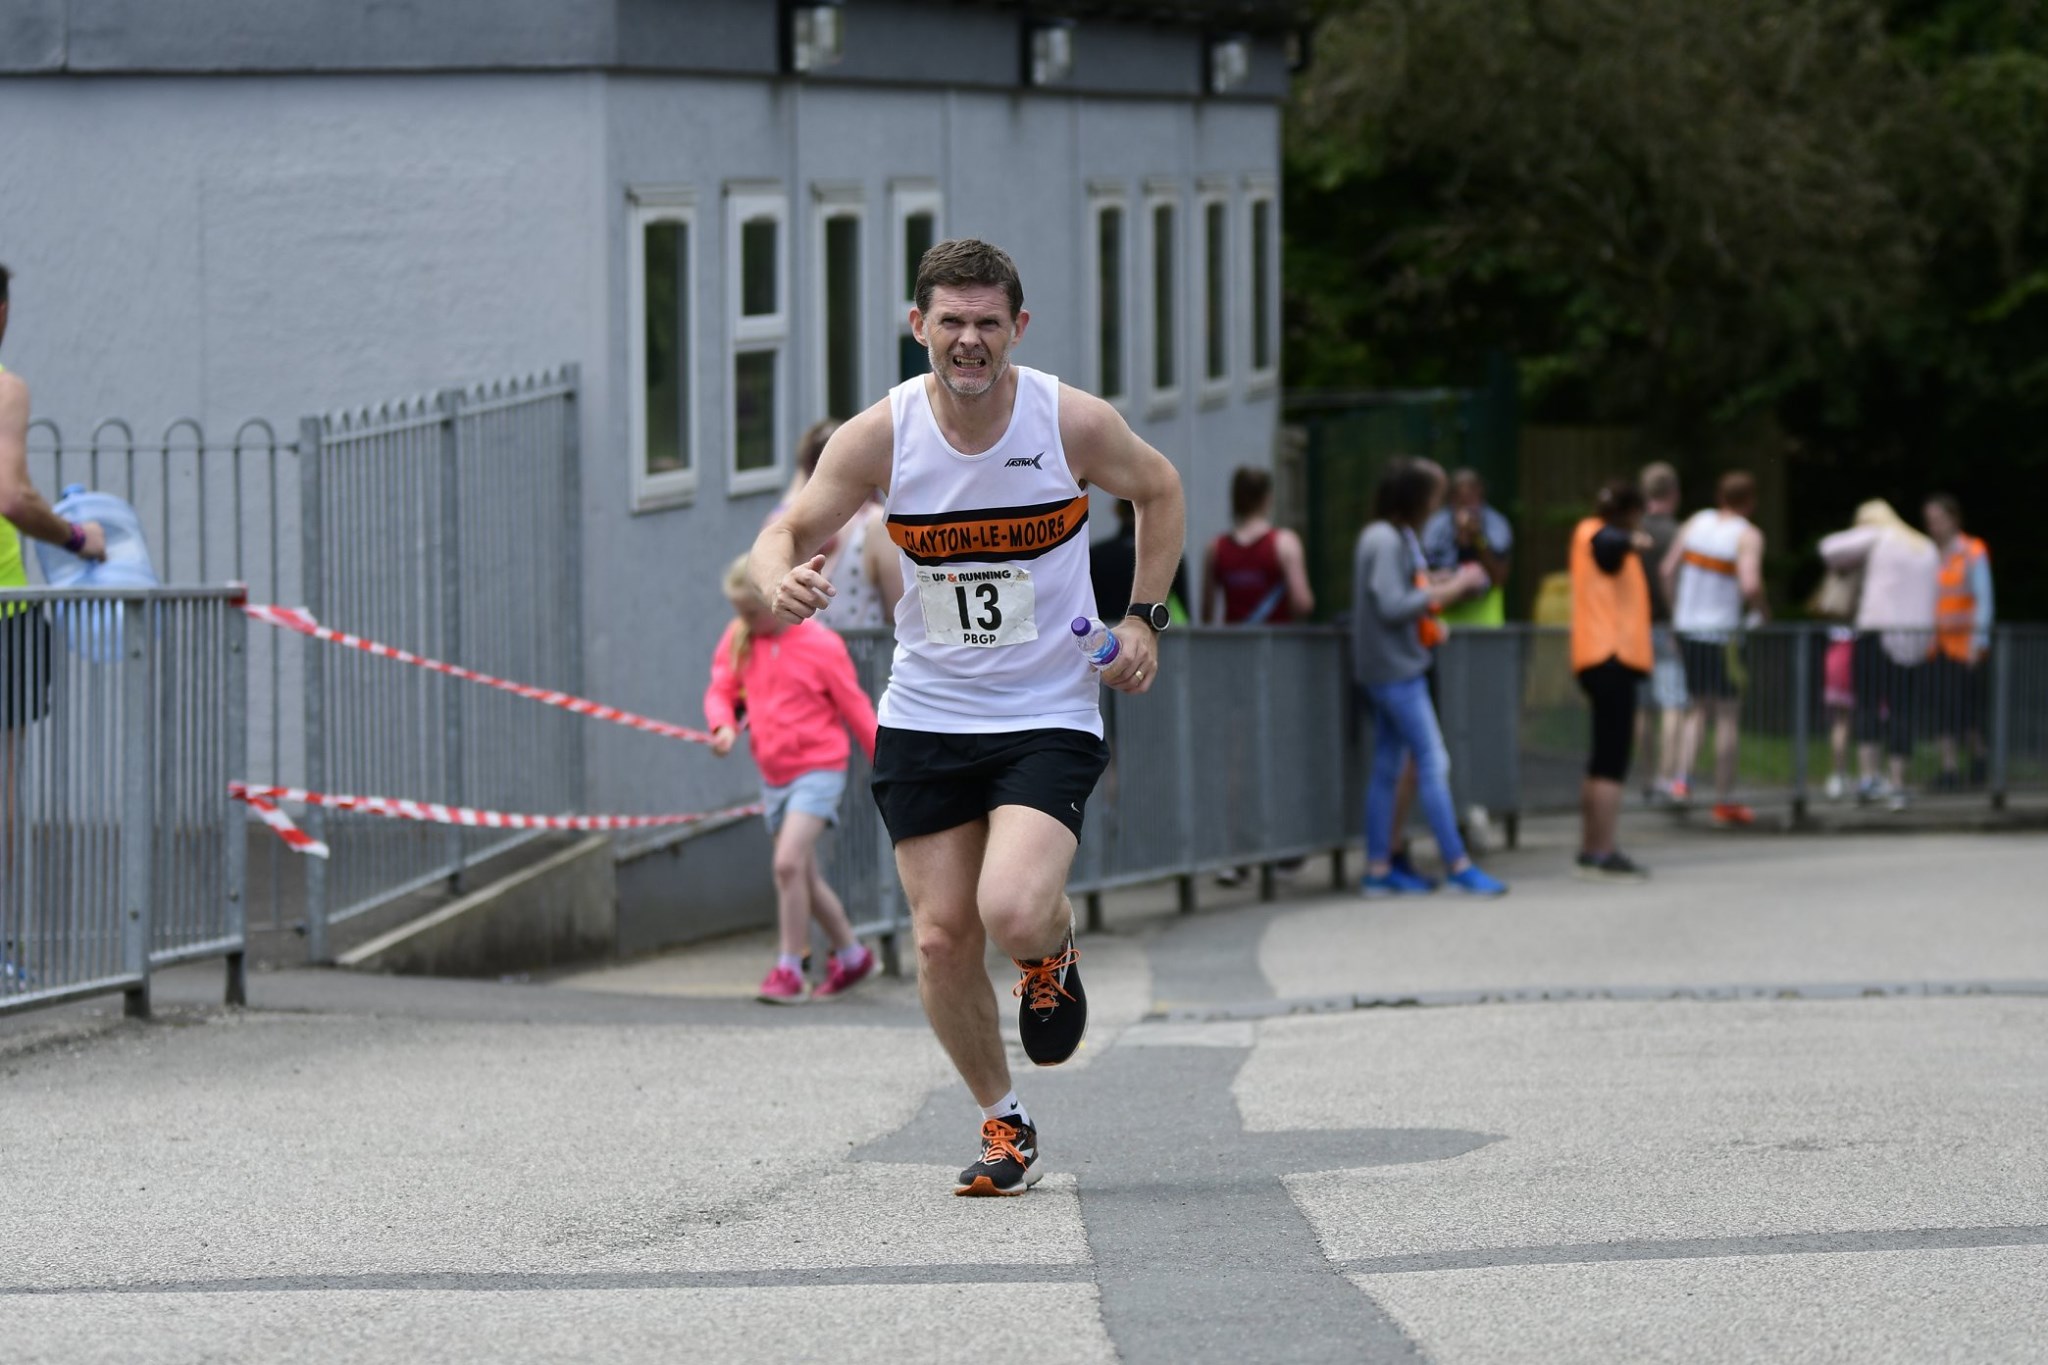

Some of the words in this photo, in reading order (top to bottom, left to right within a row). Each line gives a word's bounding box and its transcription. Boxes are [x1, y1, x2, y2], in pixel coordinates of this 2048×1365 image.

[905, 514, 1065, 553] CLAYTON-LE-MOORS
[932, 573, 946, 582] UP
[947, 573, 958, 582] &
[958, 570, 1011, 582] RUNNING
[955, 582, 1003, 631] 13
[963, 633, 997, 645] PBGP
